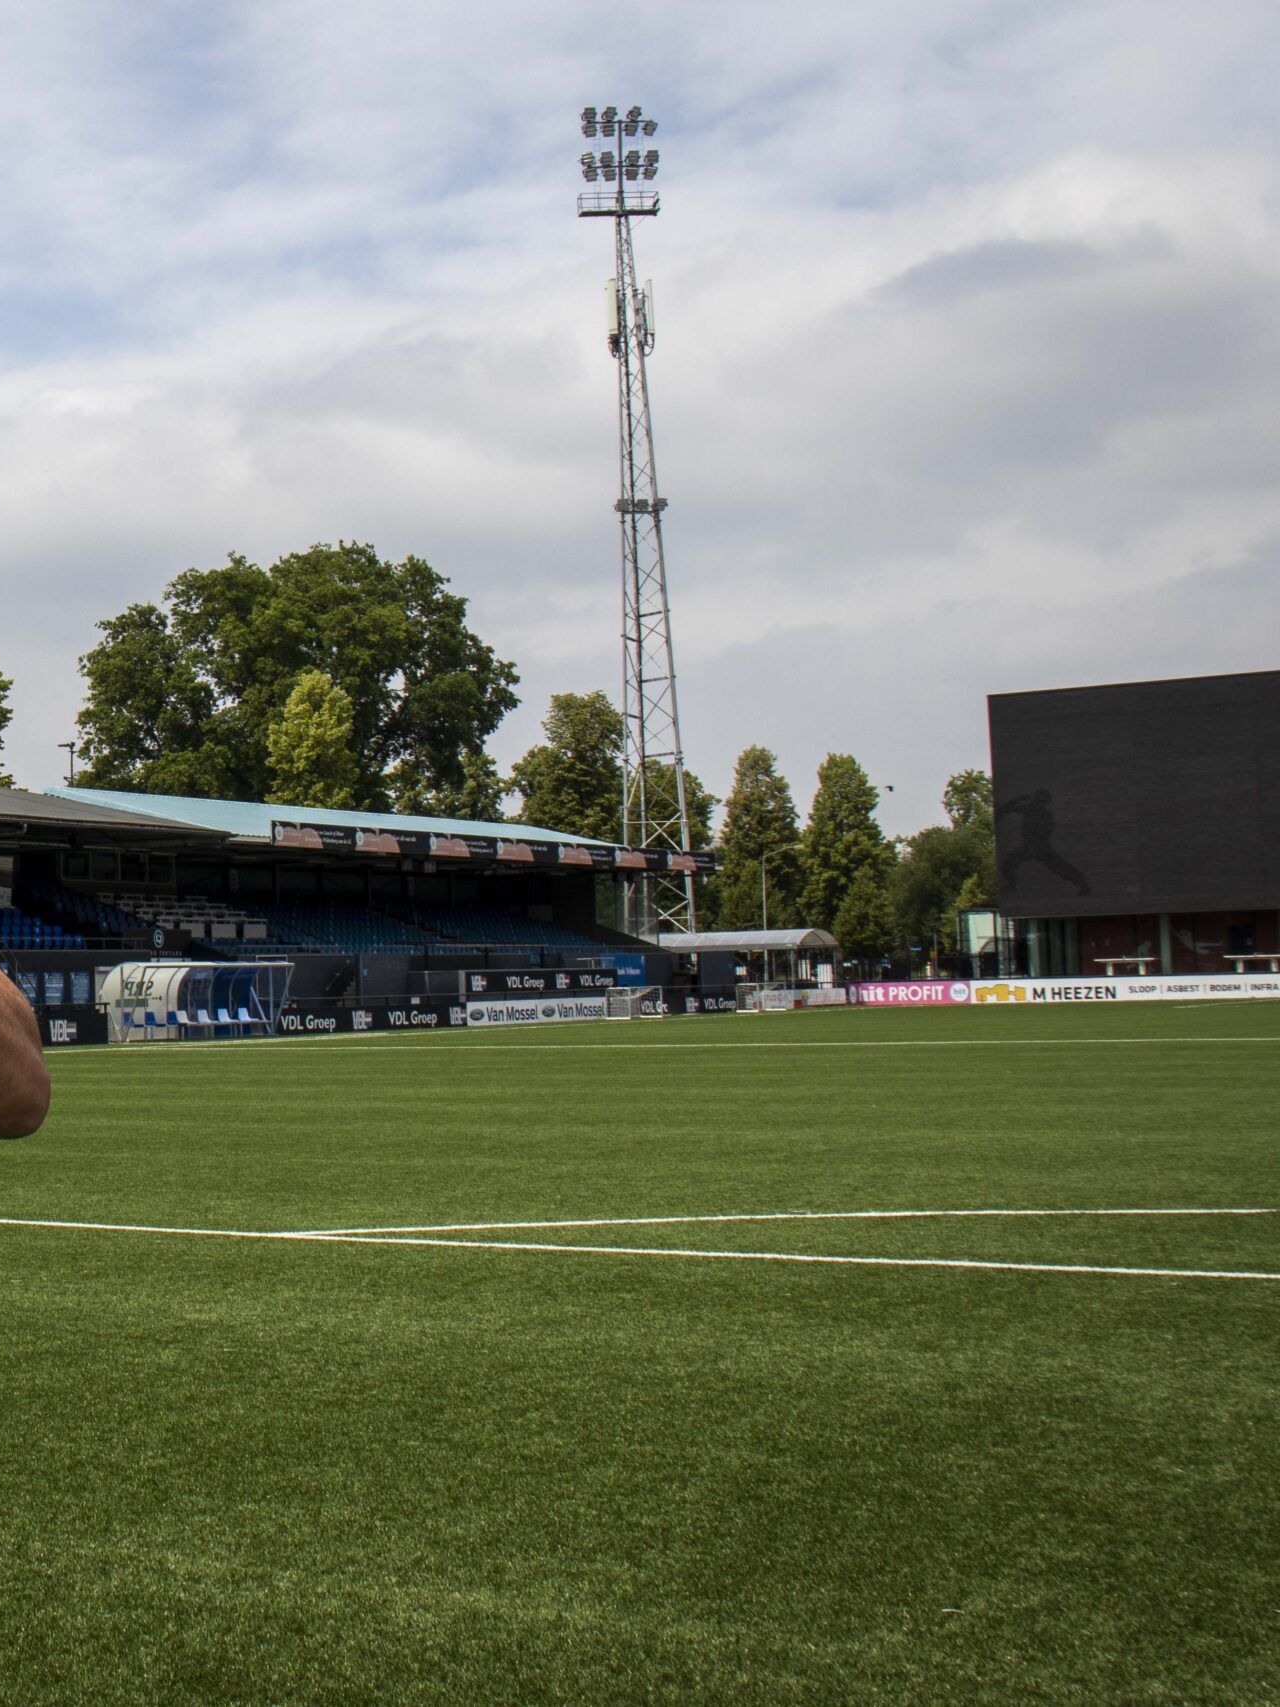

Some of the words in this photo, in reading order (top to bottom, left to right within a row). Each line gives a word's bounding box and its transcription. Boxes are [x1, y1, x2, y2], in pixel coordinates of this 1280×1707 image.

[506, 976, 523, 989] VDL
[523, 976, 545, 991] Groep
[579, 975, 593, 987] VDL
[594, 975, 614, 988] Groep
[1033, 987, 1046, 1000] M
[1052, 986, 1117, 1000] HEEZEN
[1129, 985, 1157, 994] SLOOP
[1166, 984, 1200, 992] ASBEST
[1210, 983, 1241, 992] BODEM
[1251, 983, 1279, 991] INFRA
[889, 985, 944, 1002] PROFIT
[486, 1006, 505, 1022] Van
[506, 1004, 539, 1021] Mossel
[557, 1002, 574, 1019] Van
[574, 1001, 605, 1018] Mossel
[281, 1015, 303, 1030] VDL
[306, 1015, 336, 1032] Groep
[388, 1011, 409, 1026] VDL
[411, 1010, 438, 1028] Groep
[50, 1019, 70, 1042] VDL
